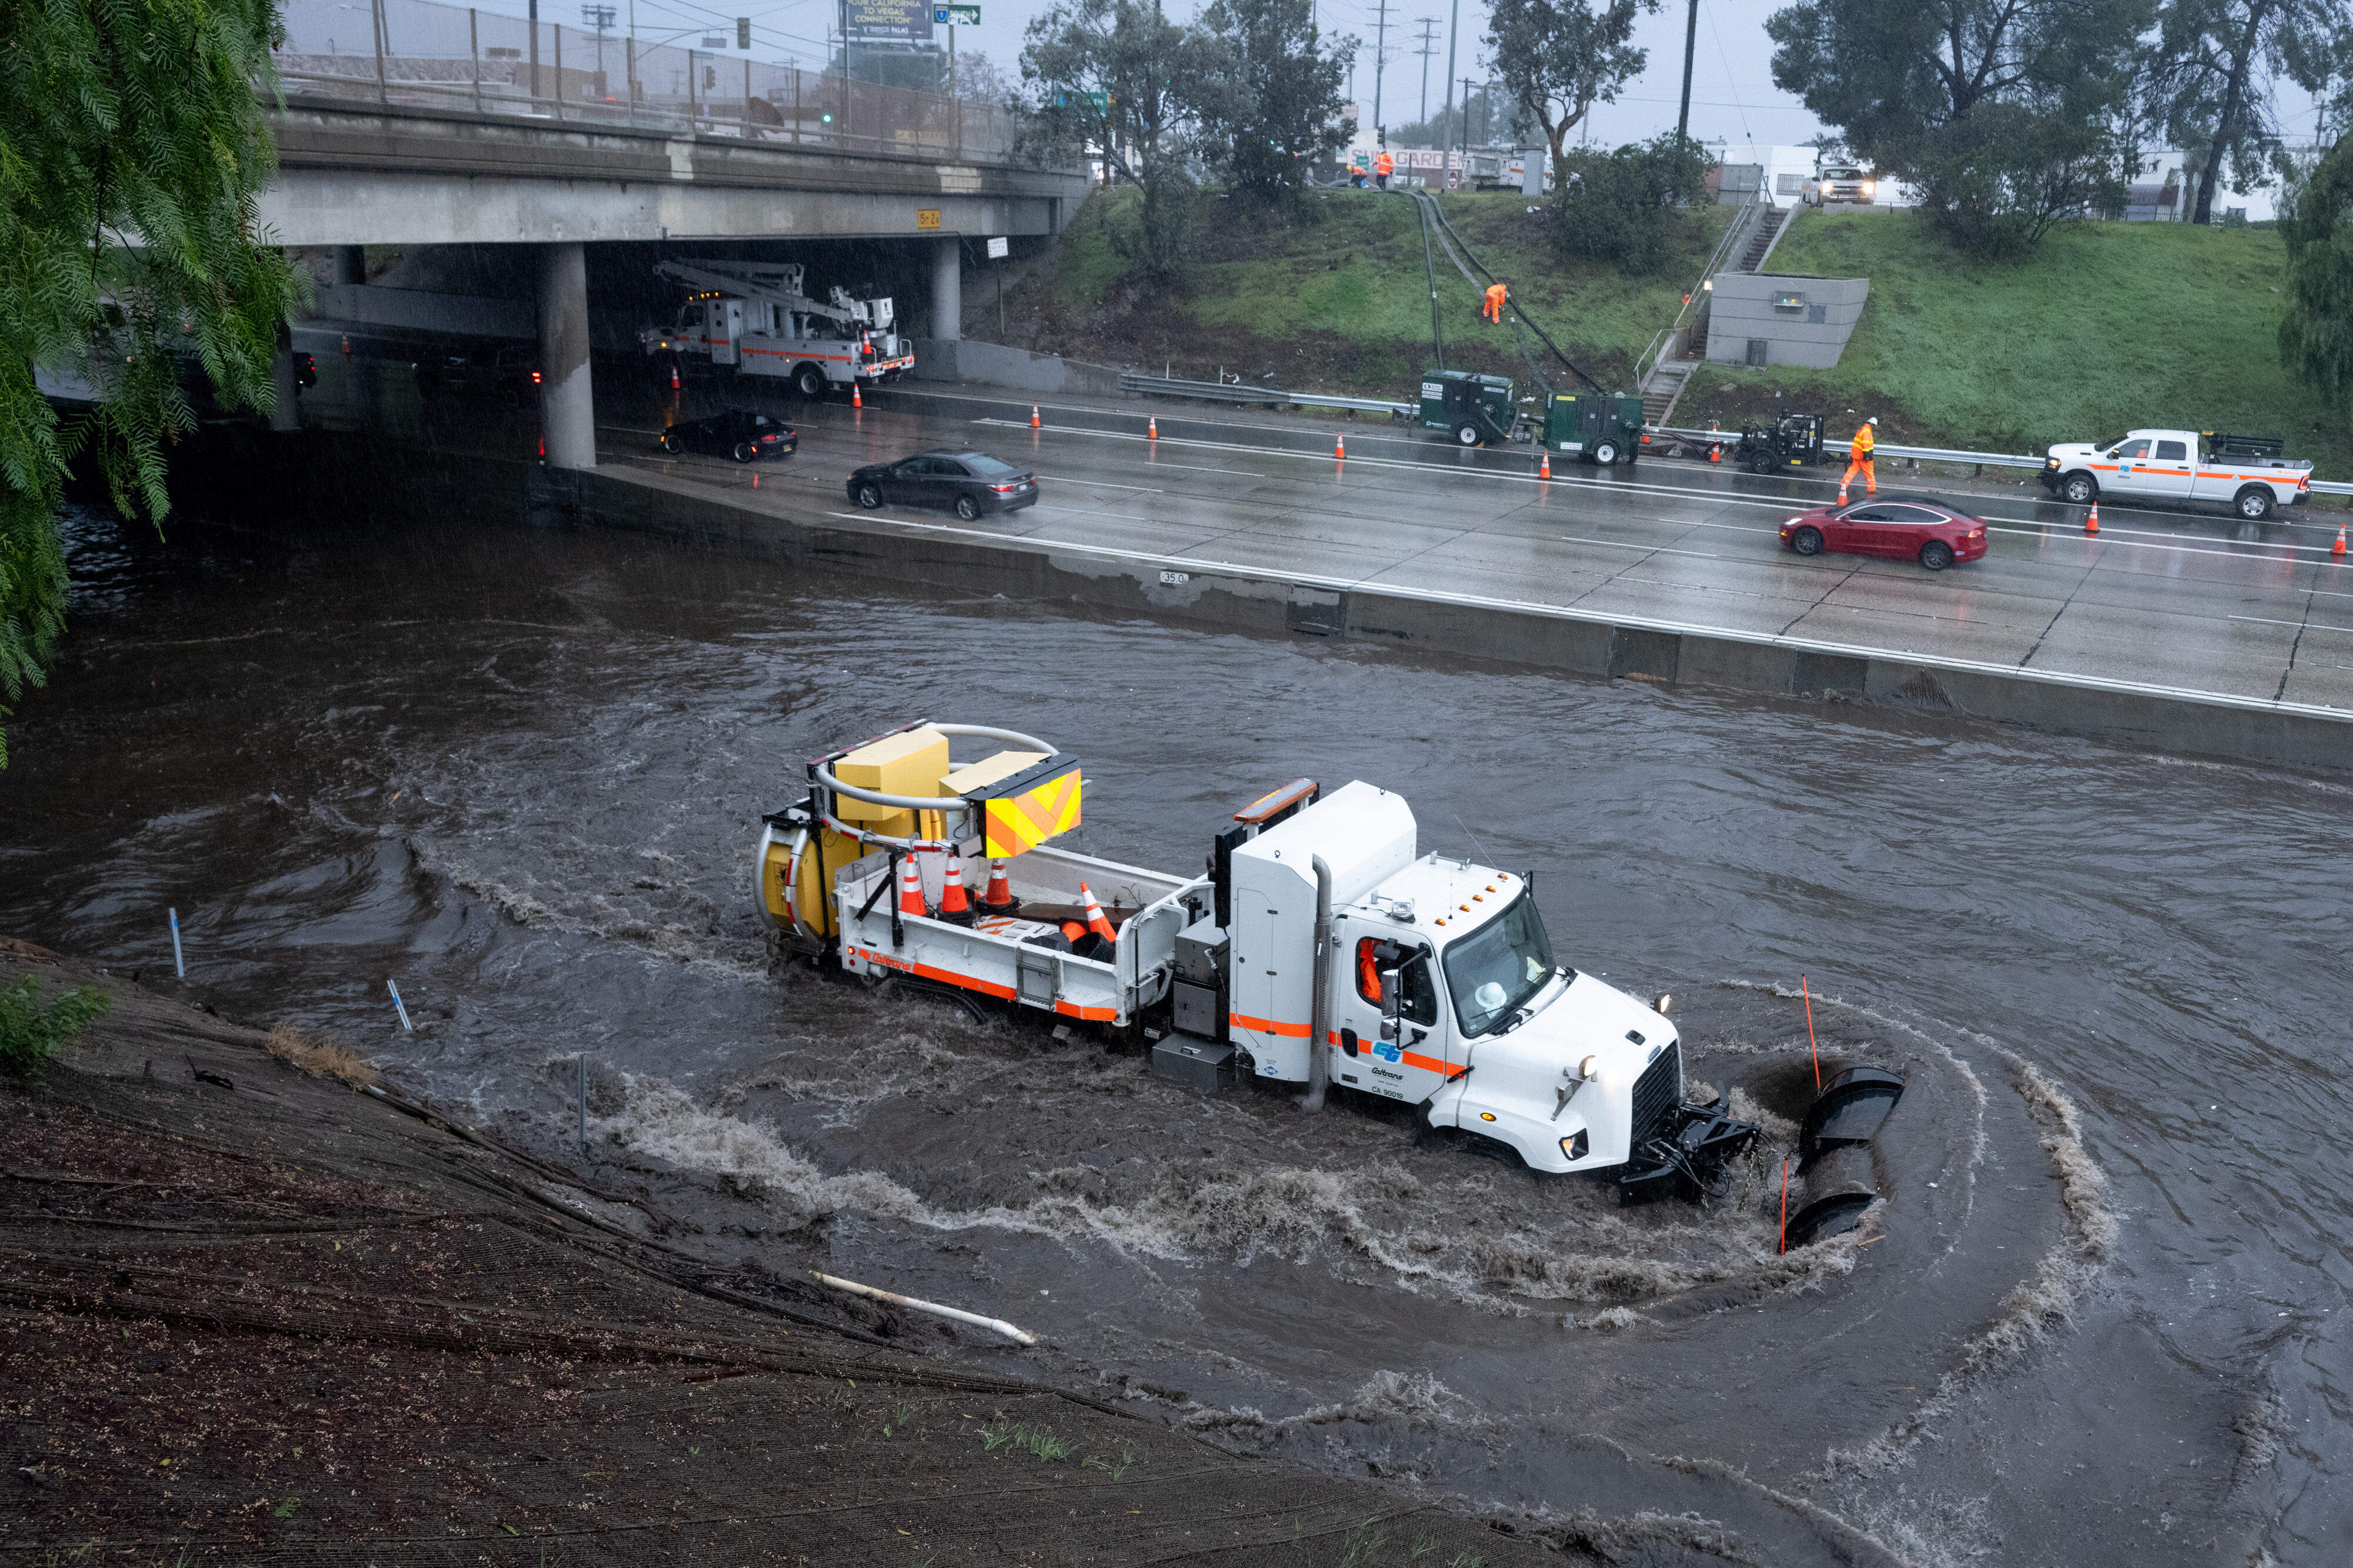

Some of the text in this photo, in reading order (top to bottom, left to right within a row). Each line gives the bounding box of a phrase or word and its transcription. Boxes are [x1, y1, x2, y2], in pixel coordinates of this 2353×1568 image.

[877, 7, 905, 15] VEGAS
[1165, 573, 1184, 583] 35.0
[872, 952, 911, 971] Caltrans
[1371, 1067, 1404, 1080] Caltrans
[1384, 1089, 1403, 1100] 90019
